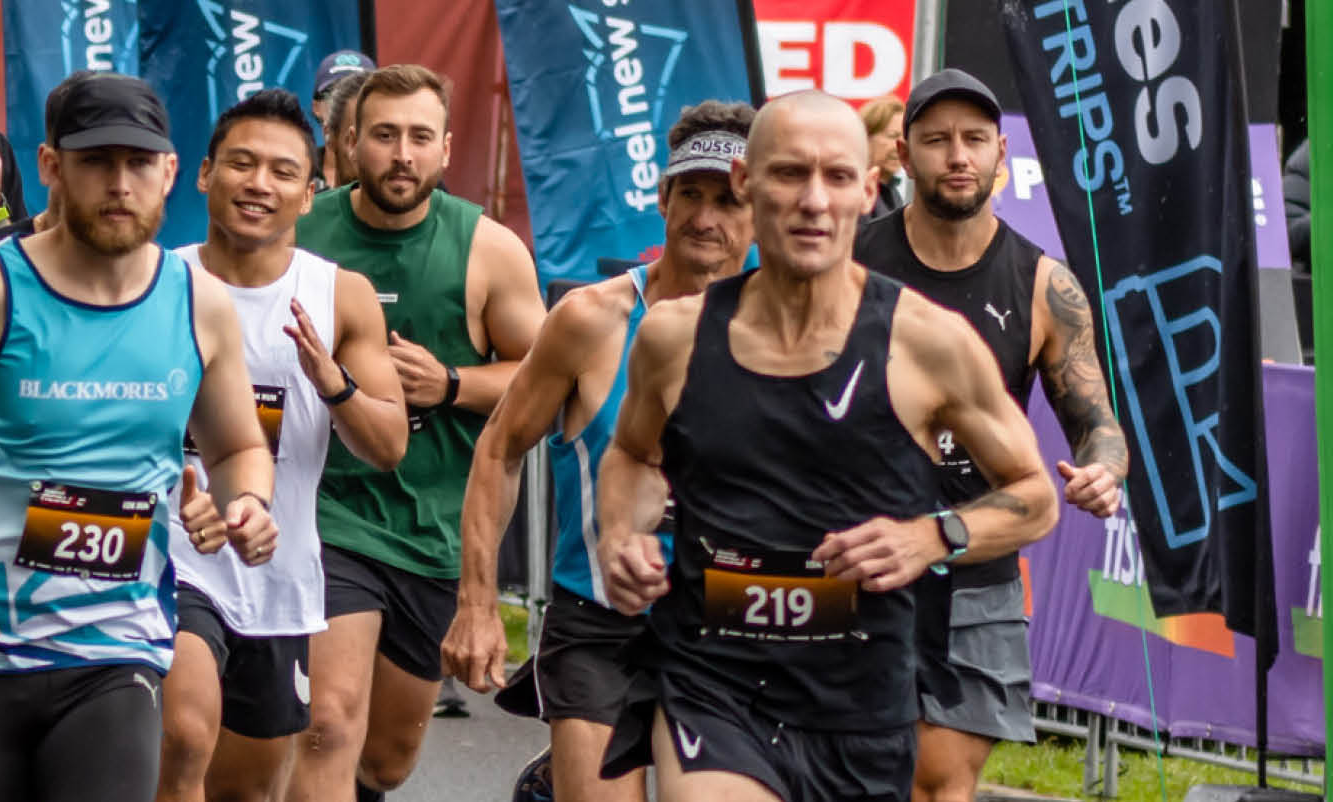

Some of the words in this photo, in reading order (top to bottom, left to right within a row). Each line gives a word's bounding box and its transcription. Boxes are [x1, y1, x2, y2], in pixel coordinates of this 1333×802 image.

[605, 16, 649, 116] new
[756, 21, 906, 99] ED
[614, 120, 660, 212] feel
[19, 379, 169, 400] BLACKMORES
[53, 522, 124, 564] 230
[744, 585, 813, 627] 219
